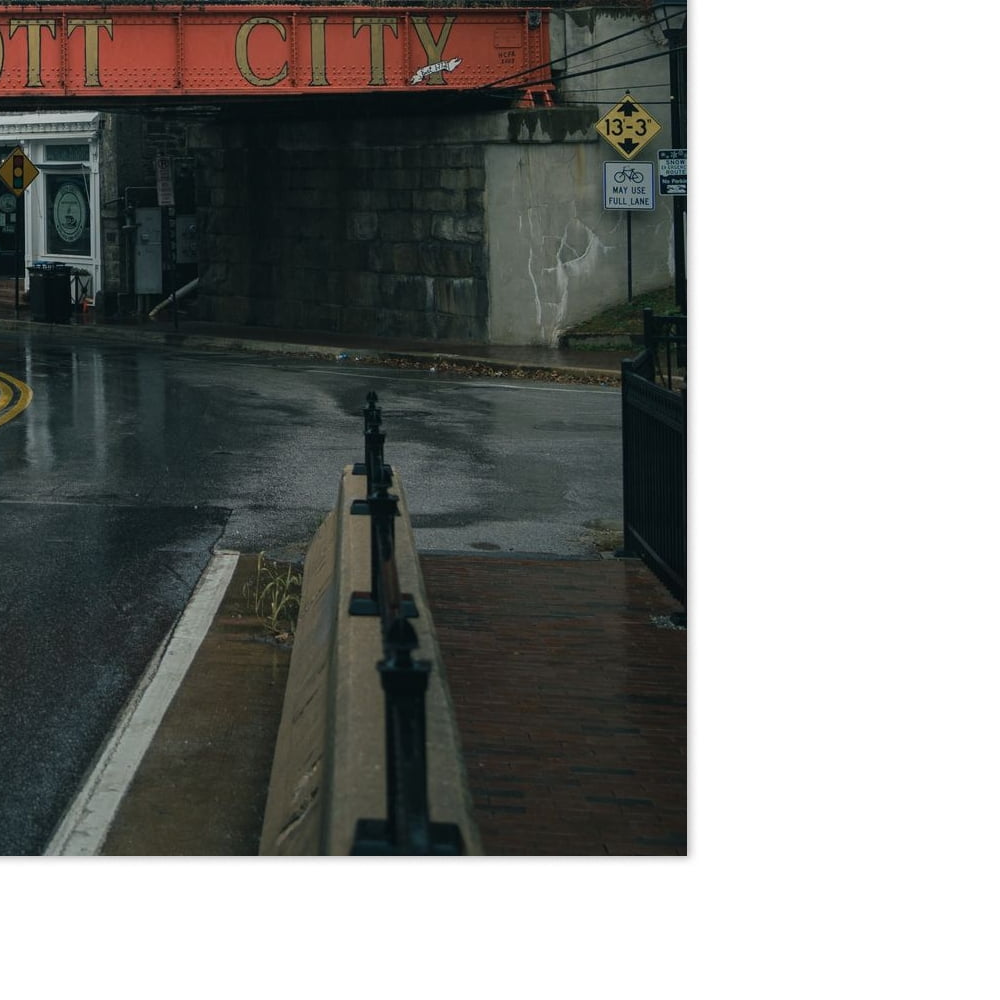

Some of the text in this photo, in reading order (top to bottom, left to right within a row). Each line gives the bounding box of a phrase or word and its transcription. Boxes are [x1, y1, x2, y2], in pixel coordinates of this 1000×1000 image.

[235, 16, 457, 87] CITY
[612, 186, 646, 194] MAY USE
[608, 197, 650, 206] FULL LANE
